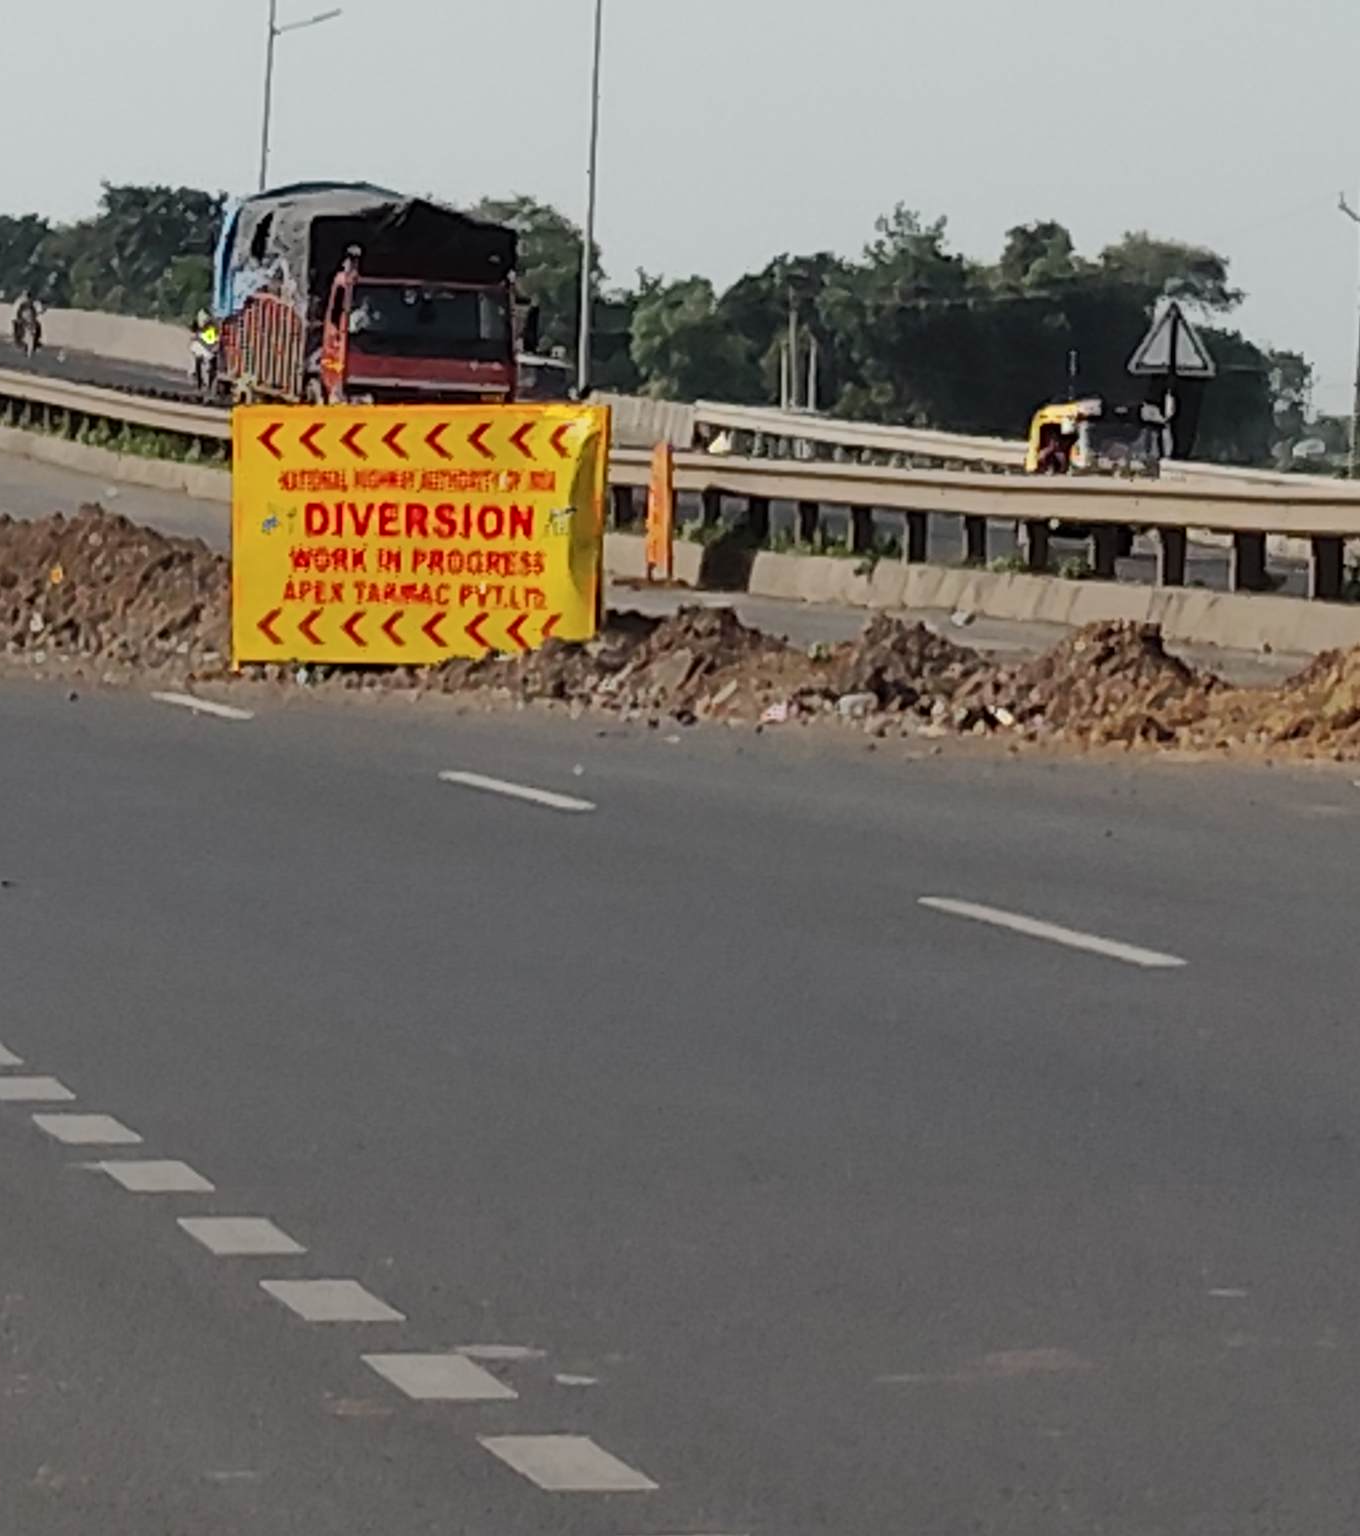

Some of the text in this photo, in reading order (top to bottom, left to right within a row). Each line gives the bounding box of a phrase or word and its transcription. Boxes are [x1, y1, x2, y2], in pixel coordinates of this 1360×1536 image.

[303, 500, 536, 541] DIVERSION
[290, 546, 546, 577] WORK IN PROGRESS
